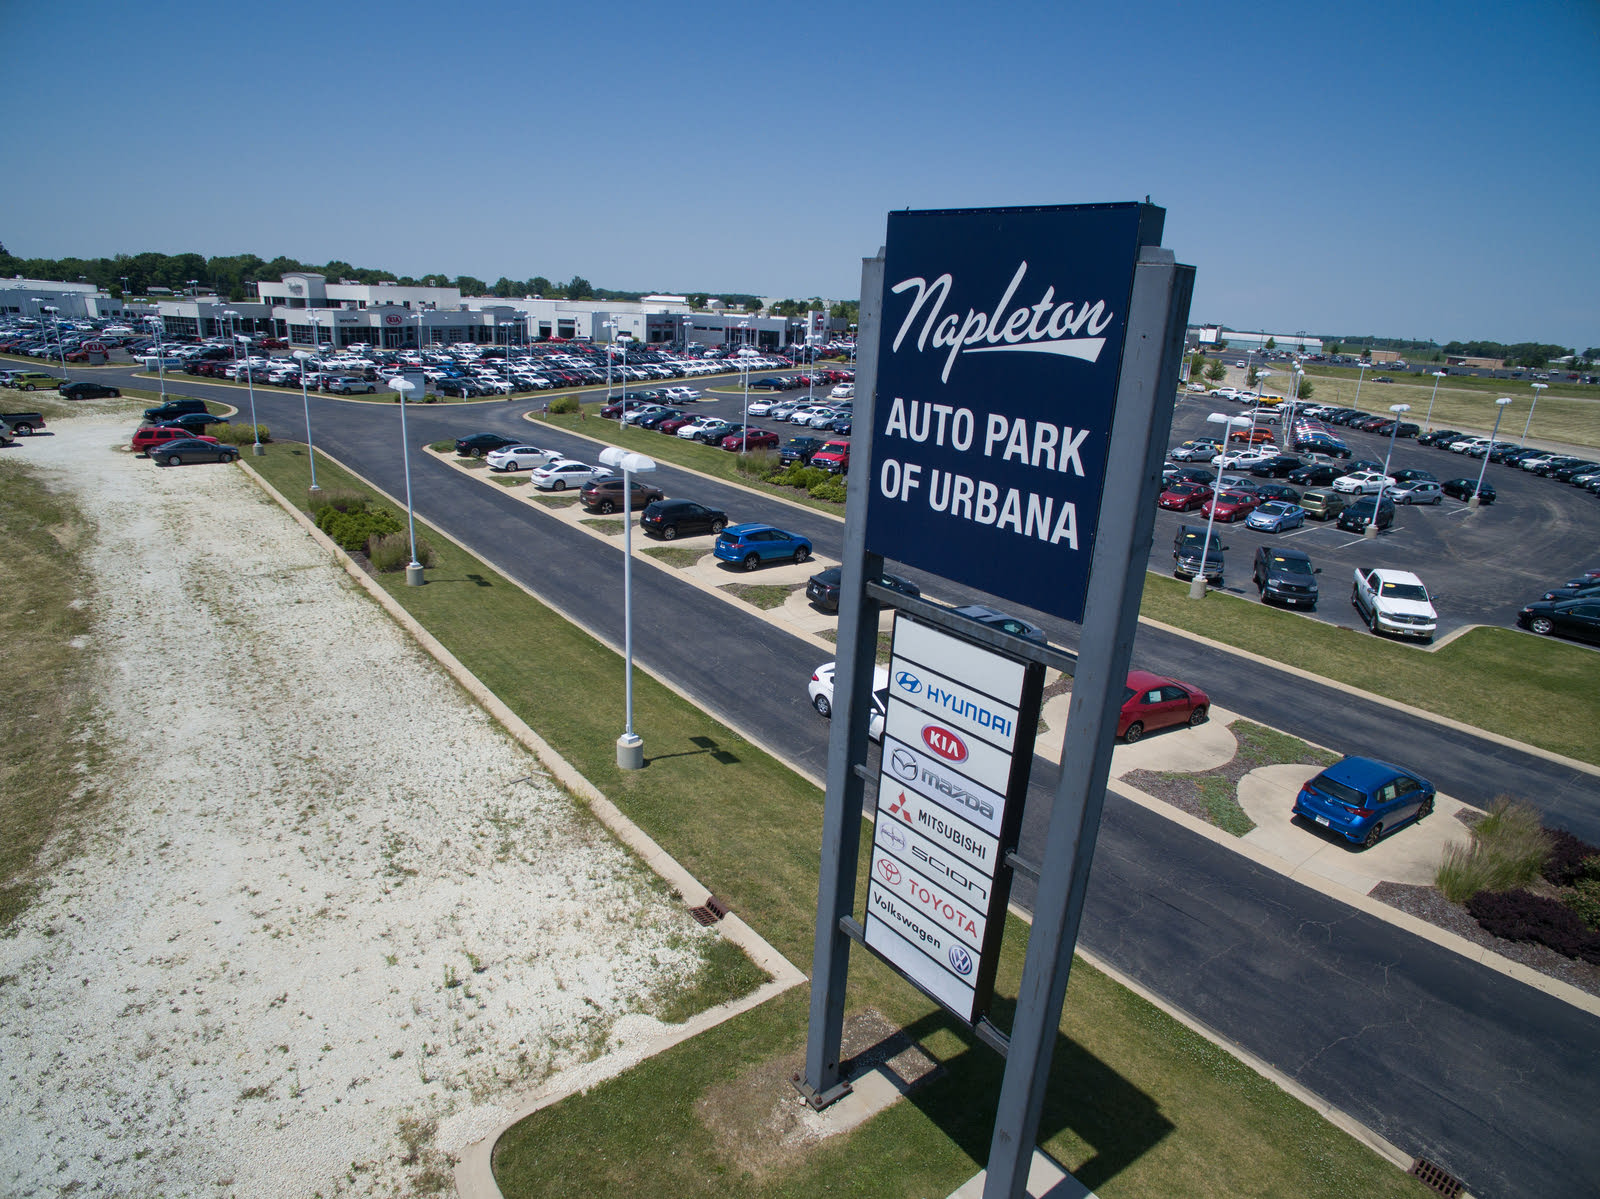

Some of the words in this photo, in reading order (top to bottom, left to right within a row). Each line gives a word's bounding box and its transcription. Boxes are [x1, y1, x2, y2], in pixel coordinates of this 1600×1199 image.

[86, 342, 104, 352] KIA
[891, 260, 1113, 383] Napleton
[884, 397, 975, 452] AUTO
[984, 413, 1090, 477] PARK
[880, 459, 921, 503] OF
[929, 468, 1079, 551] URBANA
[927, 684, 1012, 737] HYUNDAI
[929, 733, 960, 758] KIA
[921, 768, 995, 820] mazda
[918, 808, 987, 860] MITSUBISHI
[873, 891, 941, 949] Volkswagen
[908, 879, 978, 939] TOYOTA
